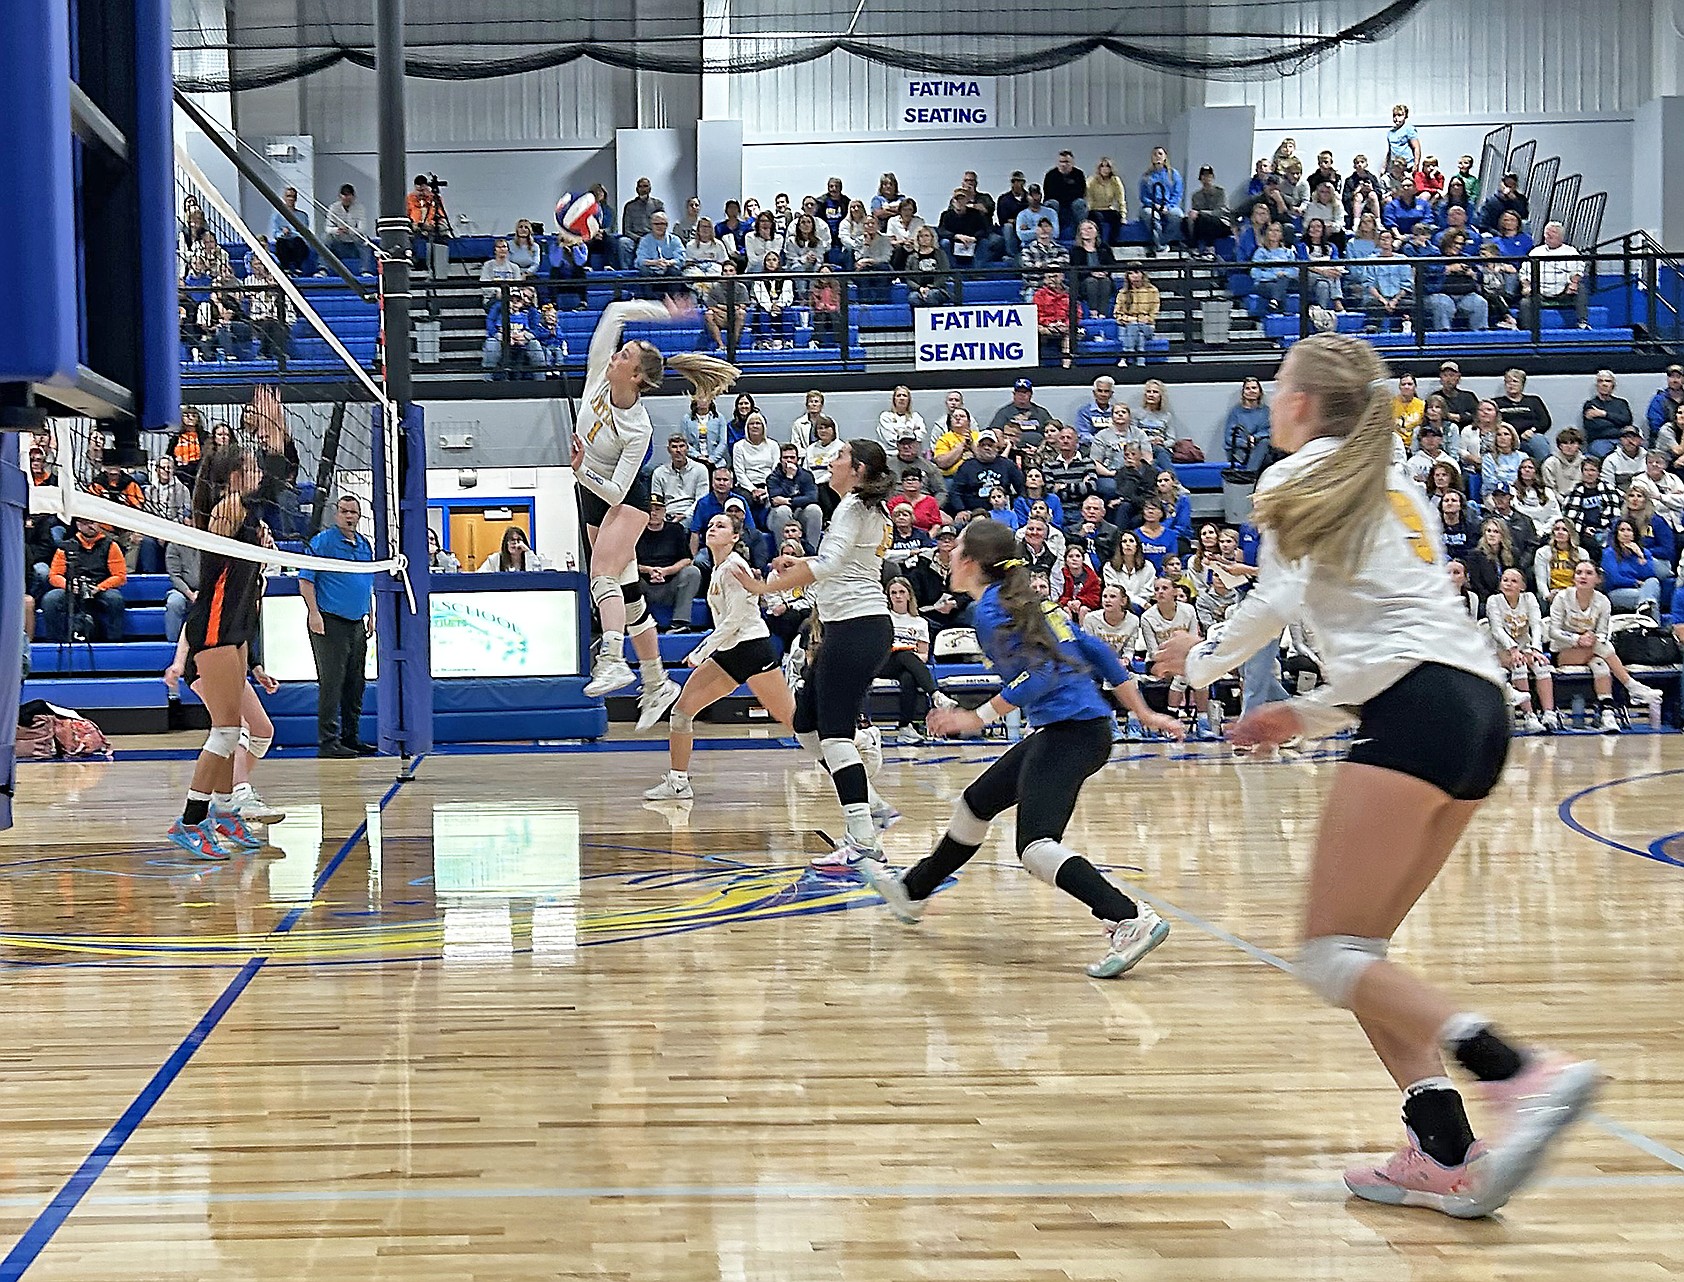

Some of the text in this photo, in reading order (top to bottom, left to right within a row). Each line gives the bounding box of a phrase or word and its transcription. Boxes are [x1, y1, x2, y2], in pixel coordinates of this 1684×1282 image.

[909, 81, 980, 96] FATIMA
[904, 108, 987, 123] SEATING
[930, 309, 1022, 330] FATIMA
[920, 342, 1023, 361] SEATING
